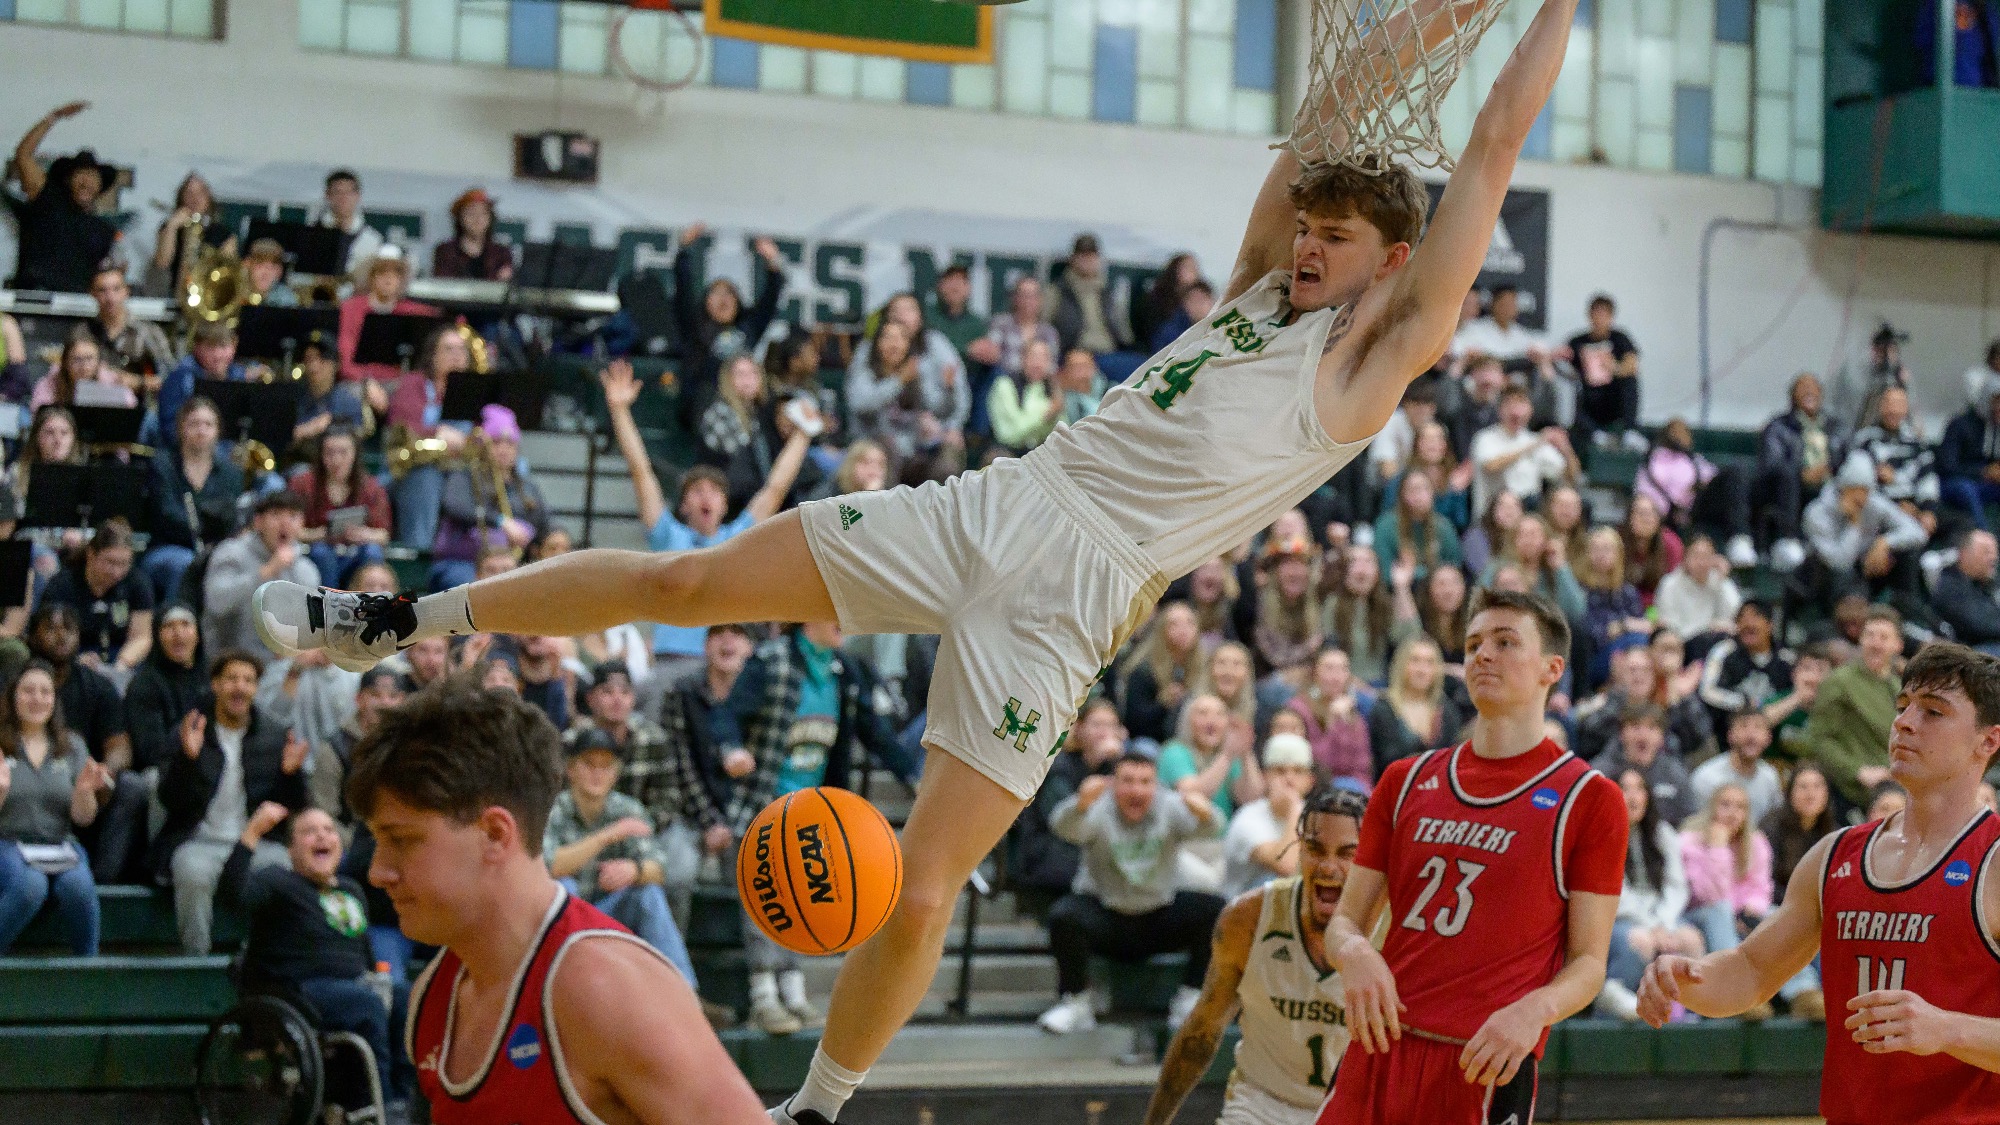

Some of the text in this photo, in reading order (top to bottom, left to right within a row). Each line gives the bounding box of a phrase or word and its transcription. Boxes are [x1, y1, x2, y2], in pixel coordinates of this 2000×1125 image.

[838, 503, 851, 531] adidas
[1412, 816, 1519, 855] TERRIERS
[753, 822, 793, 933] Wilson
[797, 824, 834, 904] NCAA
[1945, 870, 1970, 882] NCAA
[1401, 855, 1488, 938] 23
[1836, 910, 1938, 944] TERRIERS
[1307, 1033, 1327, 1088] 1
